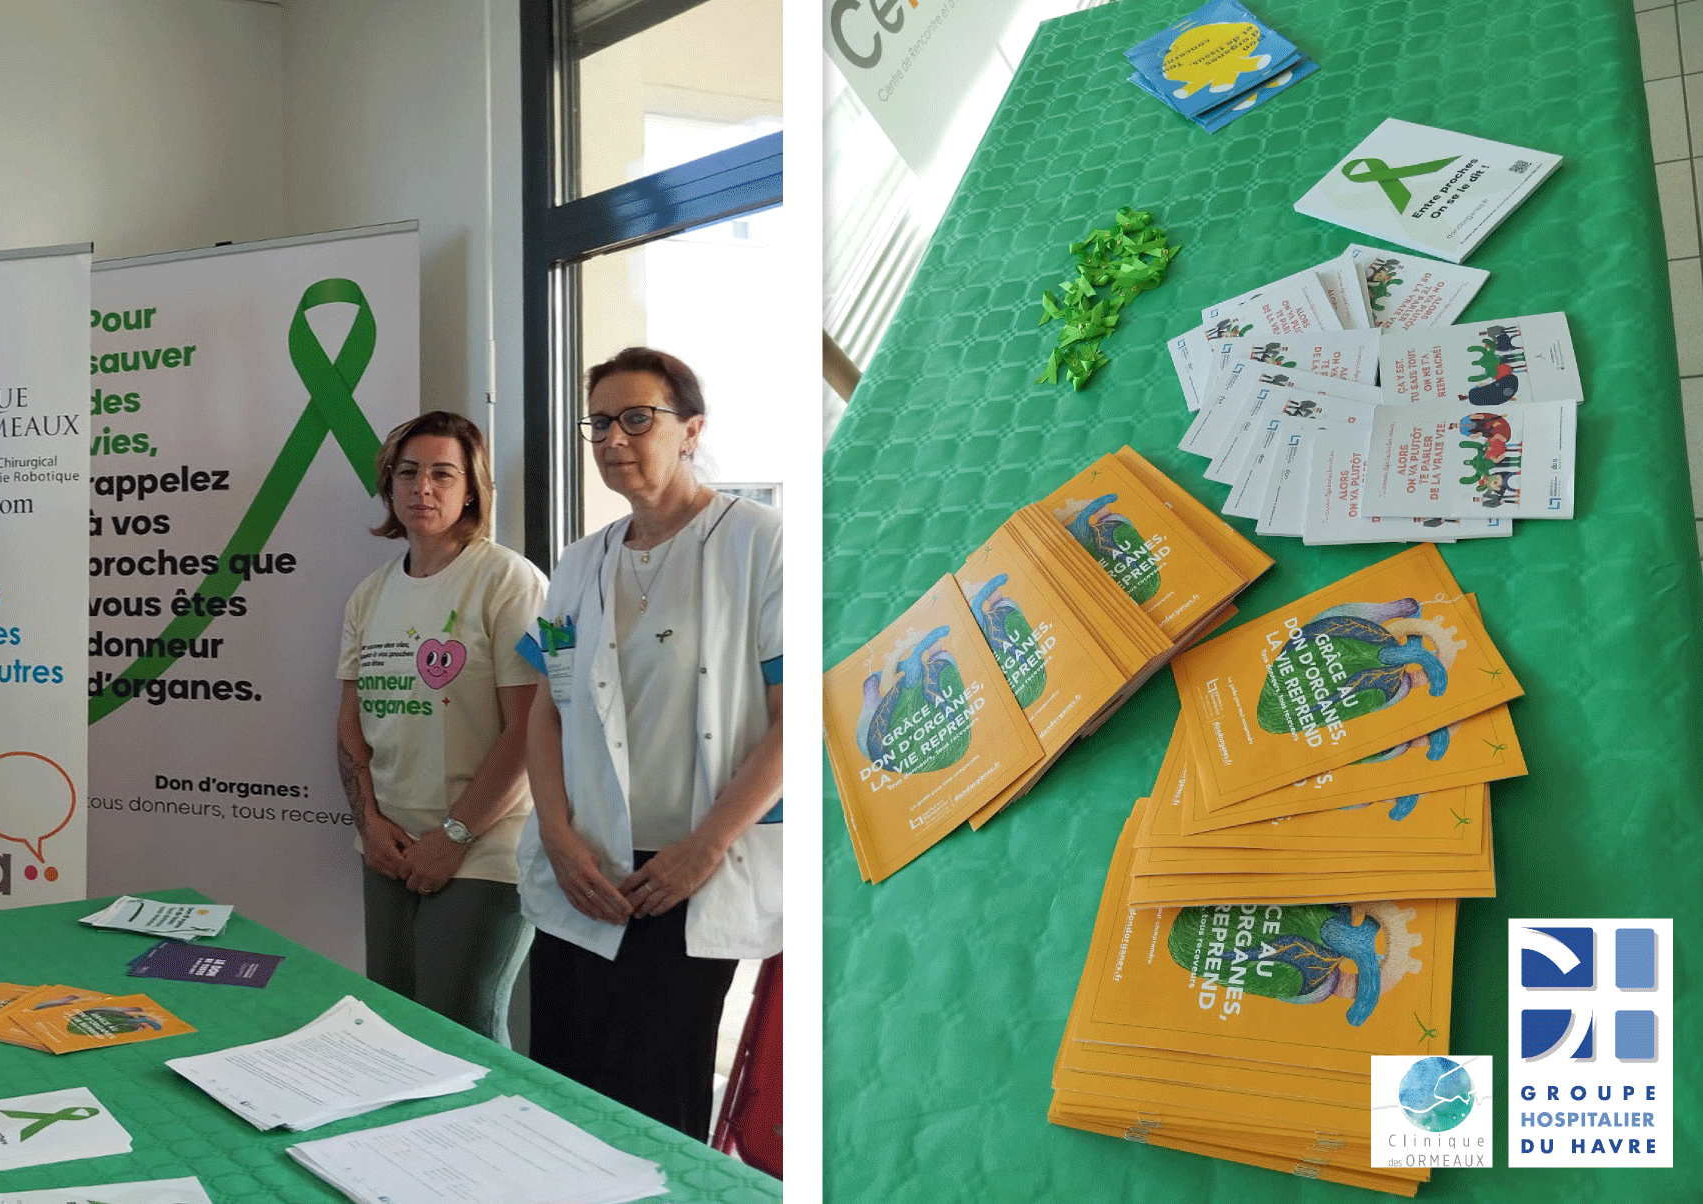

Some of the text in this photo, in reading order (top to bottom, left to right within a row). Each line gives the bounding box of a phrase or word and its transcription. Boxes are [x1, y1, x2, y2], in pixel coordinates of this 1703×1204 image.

[877, 14, 944, 102] Centre de Rencontre
[1411, 158, 1479, 219] Entre proches
[1430, 167, 1486, 219] On se le dit
[90, 388, 142, 416] des
[14, 470, 81, 485] Robotique
[1397, 444, 1409, 476] ALORS
[1406, 427, 1423, 493] ON VA PLUTÔT
[1419, 435, 1433, 484] TE PARLER
[1429, 441, 1445, 500] DE LA VRAIE
[90, 465, 230, 501] appelez
[1338, 470, 1349, 501] ALORS
[1348, 452, 1362, 518] ON VA PLUTÔT
[111, 513, 171, 536] vos
[89, 549, 297, 582] proches que
[1111, 539, 1132, 561] AU
[88, 588, 248, 618] vous êtes
[88, 631, 224, 659] donneur
[1002, 629, 1021, 654] AU
[88, 671, 262, 706] d'organes.
[357, 675, 416, 691] onneur
[1265, 630, 1323, 748] LA VIE REPREND
[1284, 617, 1308, 652] DON
[1298, 652, 1347, 745] D'ORGANES,
[1314, 633, 1359, 708] GRÂCE AU
[882, 685, 953, 747] GRÂCE AU
[1260, 648, 1269, 664] Tous
[1278, 694, 1287, 710] tous
[1284, 709, 1299, 742] receveurs
[859, 749, 897, 782] DON
[898, 680, 985, 754] D'ORGANES,
[870, 697, 985, 793] LA VIE REPREND
[886, 778, 903, 791] Tous
[935, 742, 950, 755] tous
[950, 718, 980, 743] receveurs
[155, 775, 193, 791] Don
[954, 761, 1000, 802] dondorganes.fr
[87, 795, 355, 826] ous donneurs, tous receve
[1113, 908, 1137, 983] dondorganes.fr
[1147, 921, 1161, 965] comprendre
[1188, 914, 1209, 989] tous receveurs
[1198, 905, 1232, 1010] REPREND
[1256, 941, 1276, 978] AU
